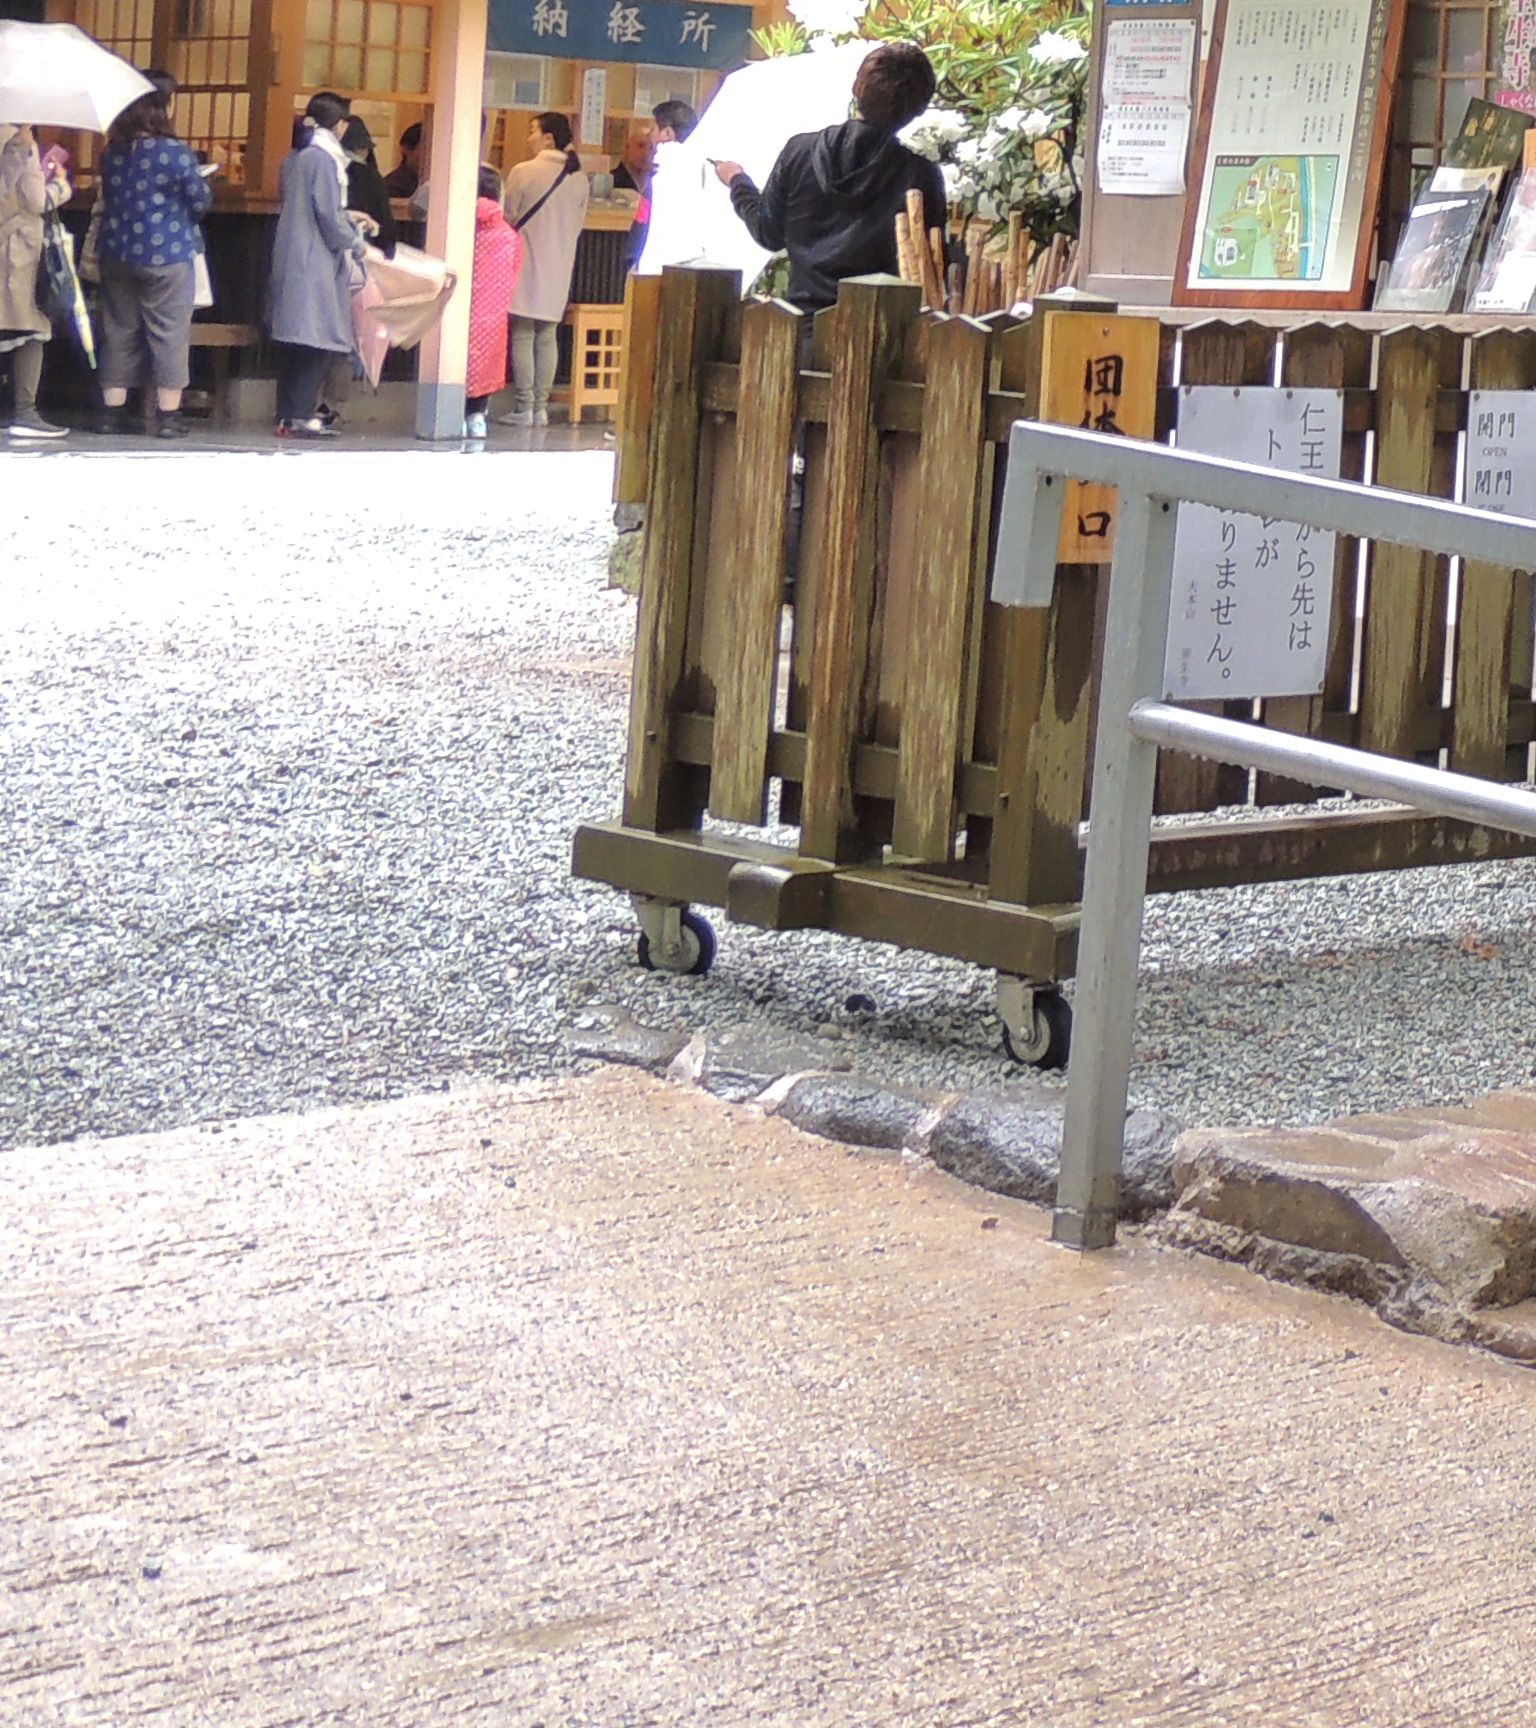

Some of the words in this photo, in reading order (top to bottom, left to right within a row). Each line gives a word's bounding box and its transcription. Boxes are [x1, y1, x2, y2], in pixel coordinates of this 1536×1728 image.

[1075, 353, 1126, 538] 団体口
[1476, 412, 1516, 439] 開門
[1482, 446, 1508, 457] OPEN
[1206, 509, 1238, 681] りません。
